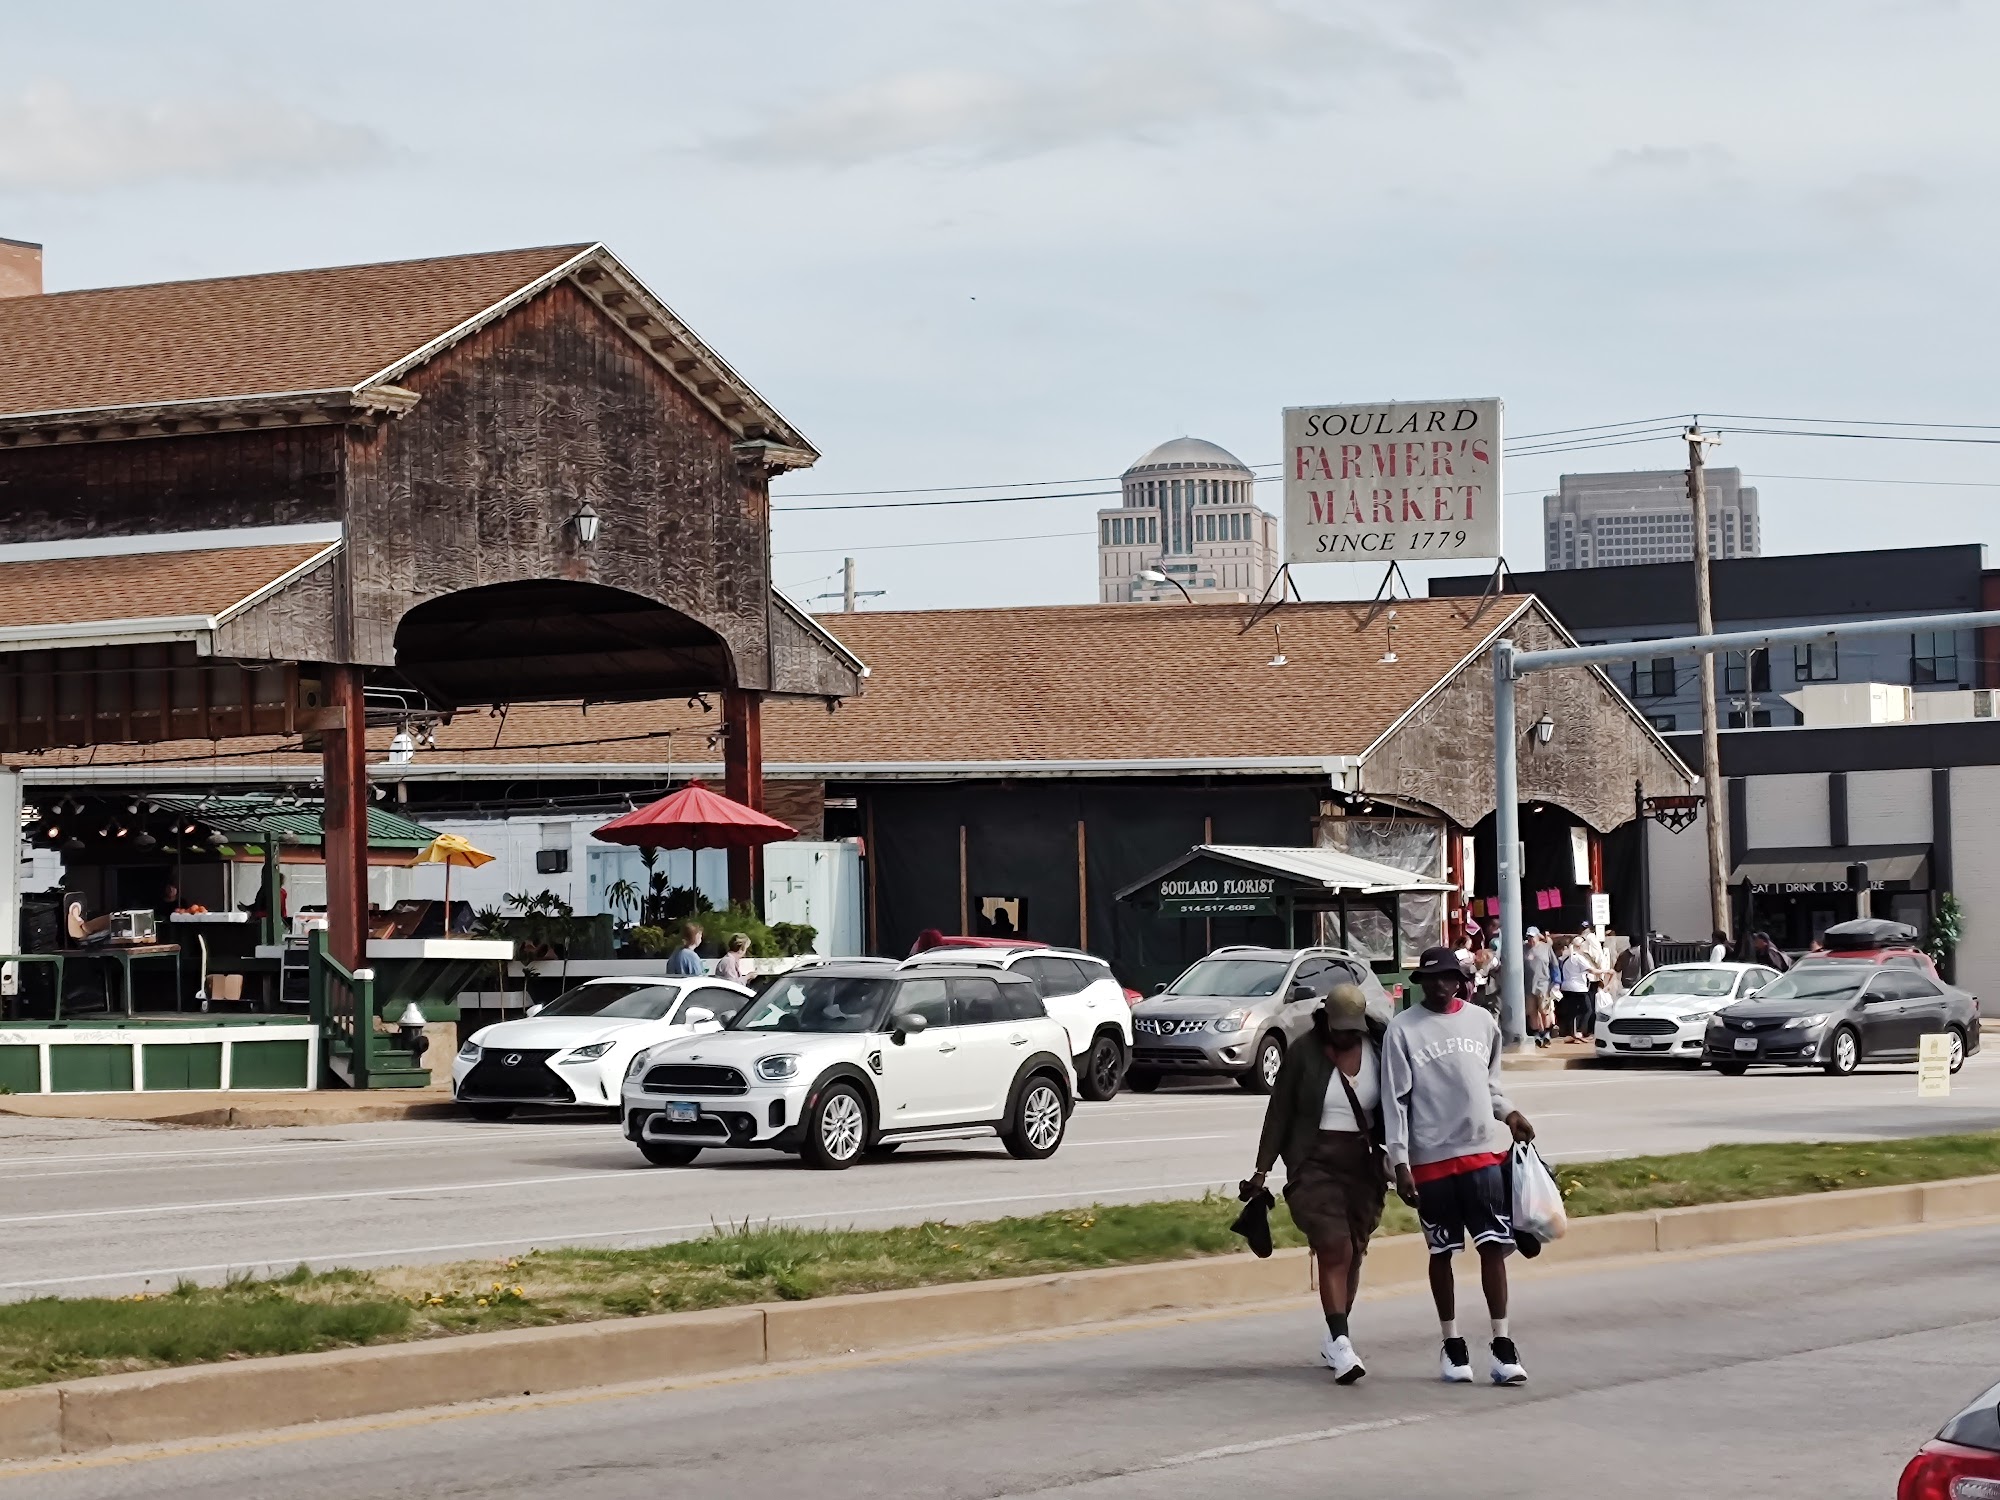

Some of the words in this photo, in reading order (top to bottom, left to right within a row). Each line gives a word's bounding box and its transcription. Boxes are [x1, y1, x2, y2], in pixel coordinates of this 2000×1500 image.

[1305, 409, 1478, 437] SOULARD
[1295, 438, 1490, 481] FARMER'S
[1306, 485, 1482, 525] MARKET
[1316, 533, 1396, 553] SINCE
[1409, 530, 1467, 550] 1779
[1160, 880, 1218, 895] SOULARD
[1223, 879, 1275, 894] FLORIST
[1751, 884, 1769, 894] EAT
[1785, 882, 1817, 893] DRINK
[1832, 880, 1885, 892] SOIZE
